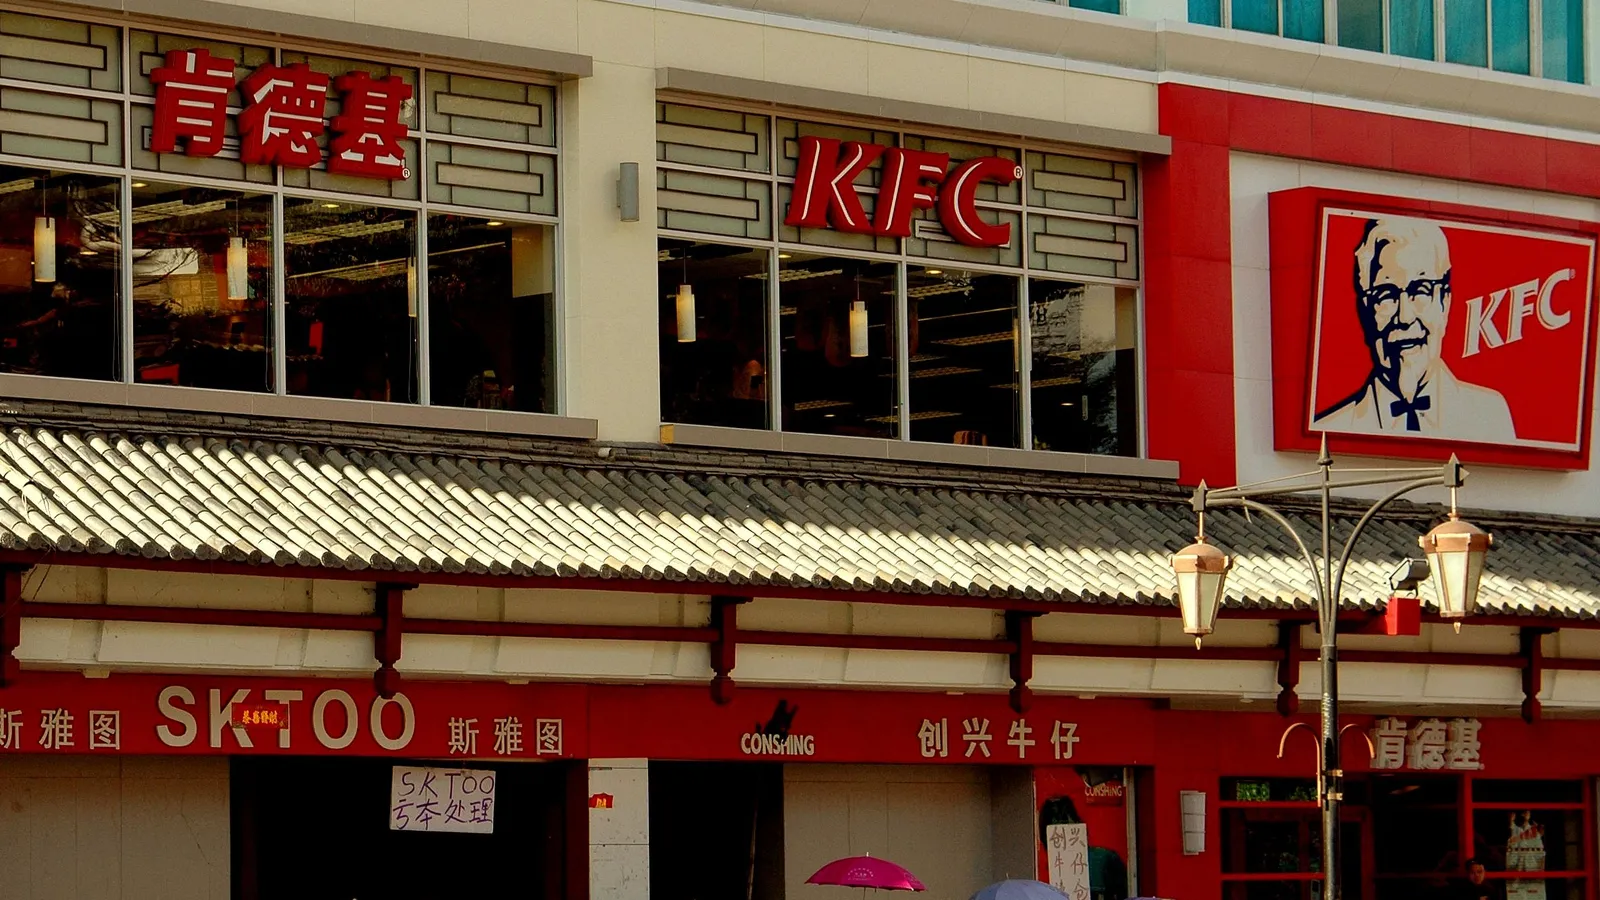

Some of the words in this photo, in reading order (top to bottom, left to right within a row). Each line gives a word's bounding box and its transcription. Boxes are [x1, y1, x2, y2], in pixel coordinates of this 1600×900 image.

[149, 47, 413, 181] 肯德基
[784, 135, 1016, 248] KFC
[1461, 268, 1572, 359] KFC
[448, 716, 563, 756] 斯雅图
[918, 717, 1080, 760] 创兴牛仔
[1369, 716, 1483, 770] 肯德基
[393, 798, 494, 830] 亏本处理
